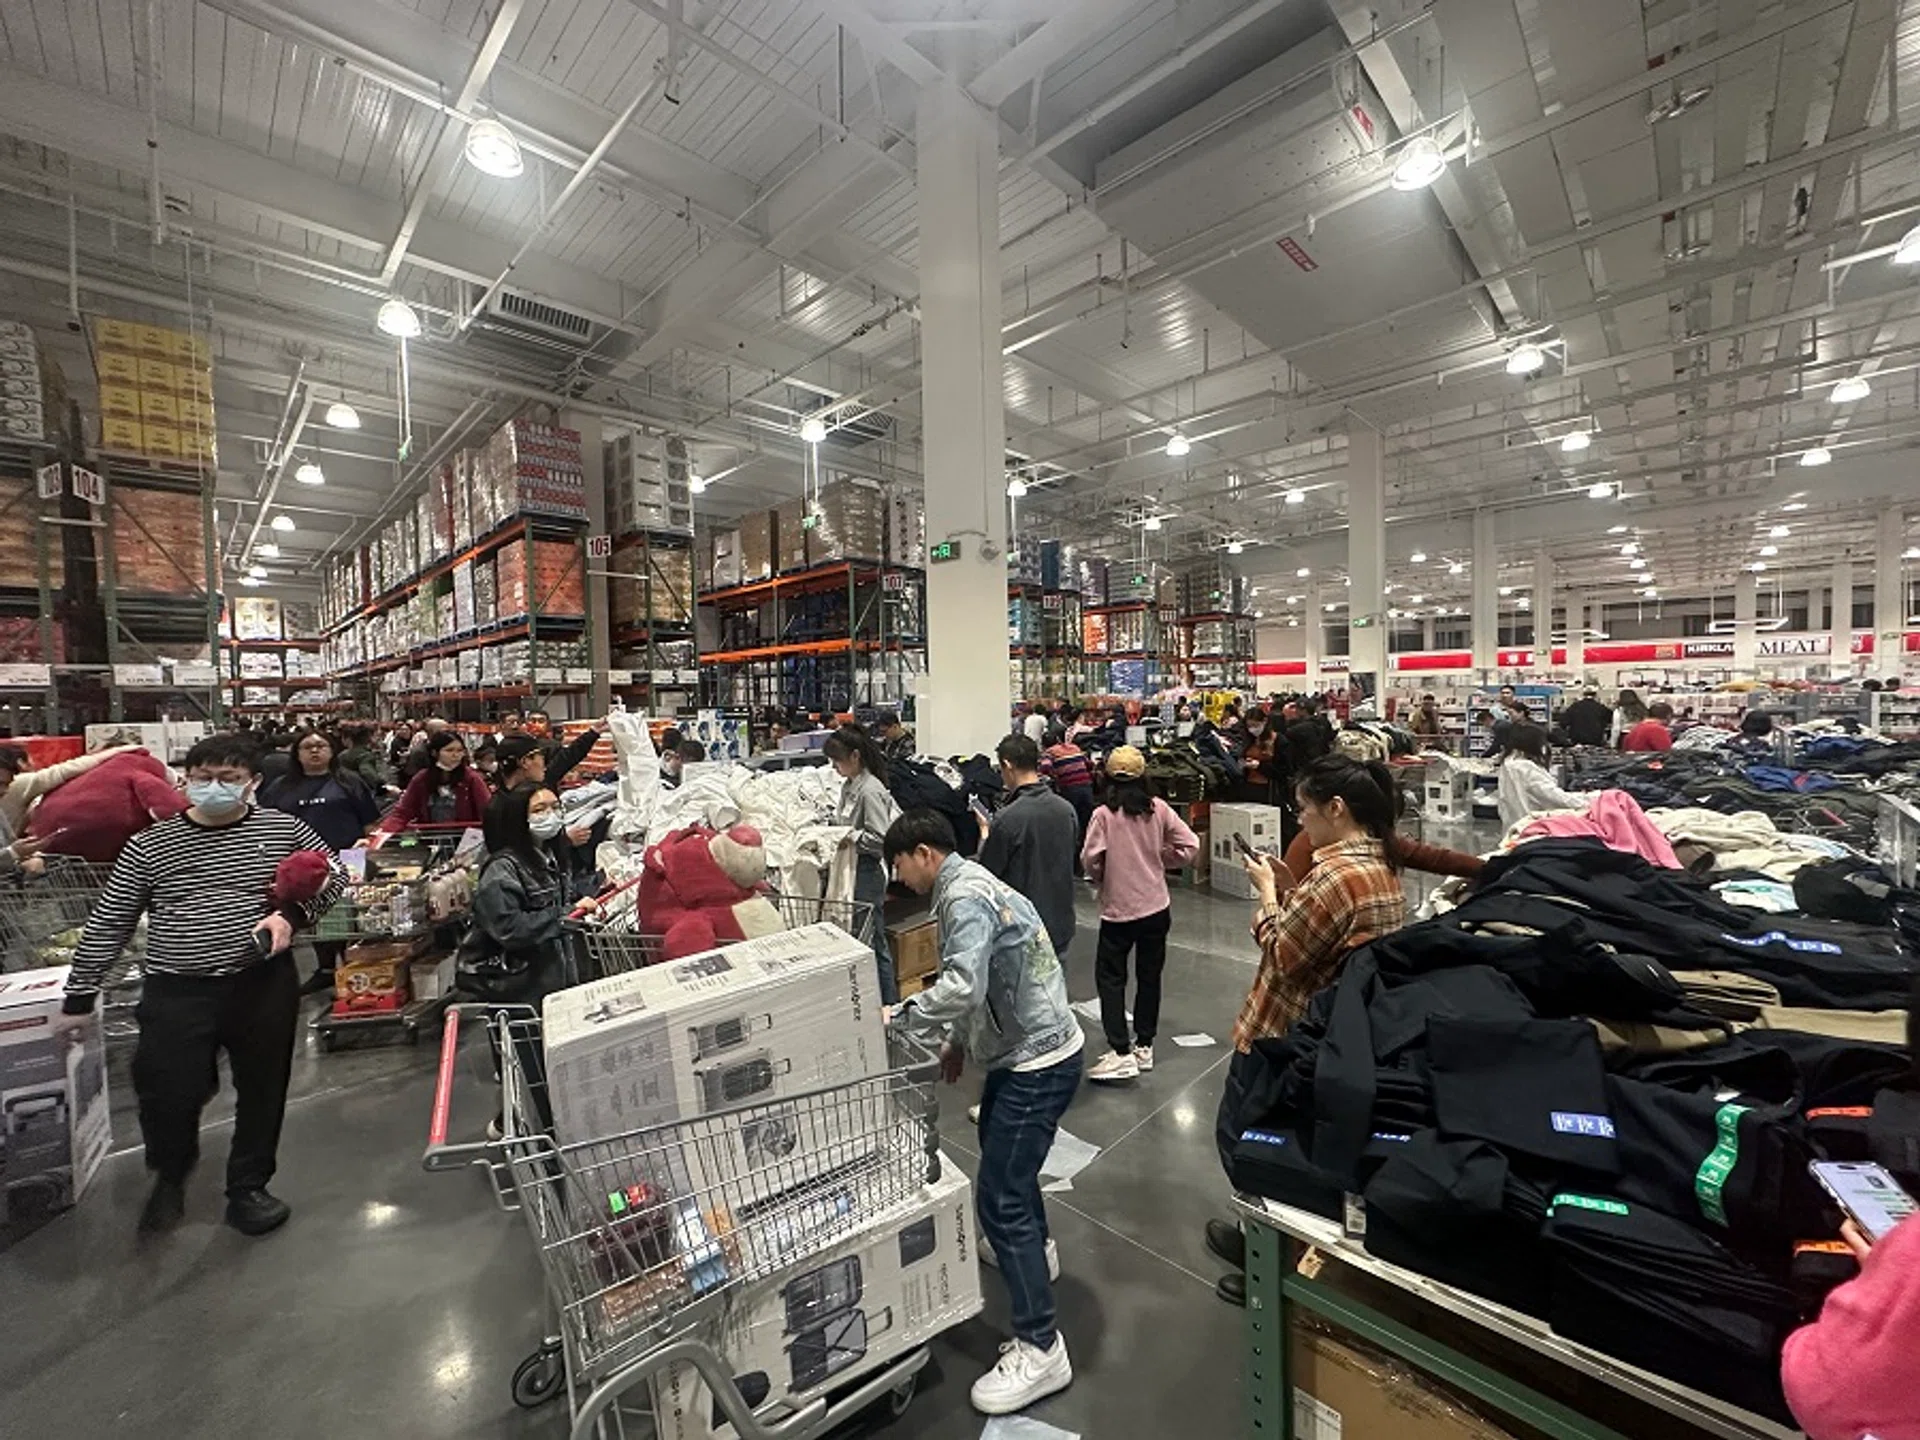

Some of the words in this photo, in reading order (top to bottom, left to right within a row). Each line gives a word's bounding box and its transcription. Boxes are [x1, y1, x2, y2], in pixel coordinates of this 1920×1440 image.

[75, 469, 99, 501] 104
[589, 537, 609, 556] 105
[885, 575, 902, 590] 107
[1687, 643, 1735, 653] KIRKLA
[1760, 639, 1821, 654] MEAT
